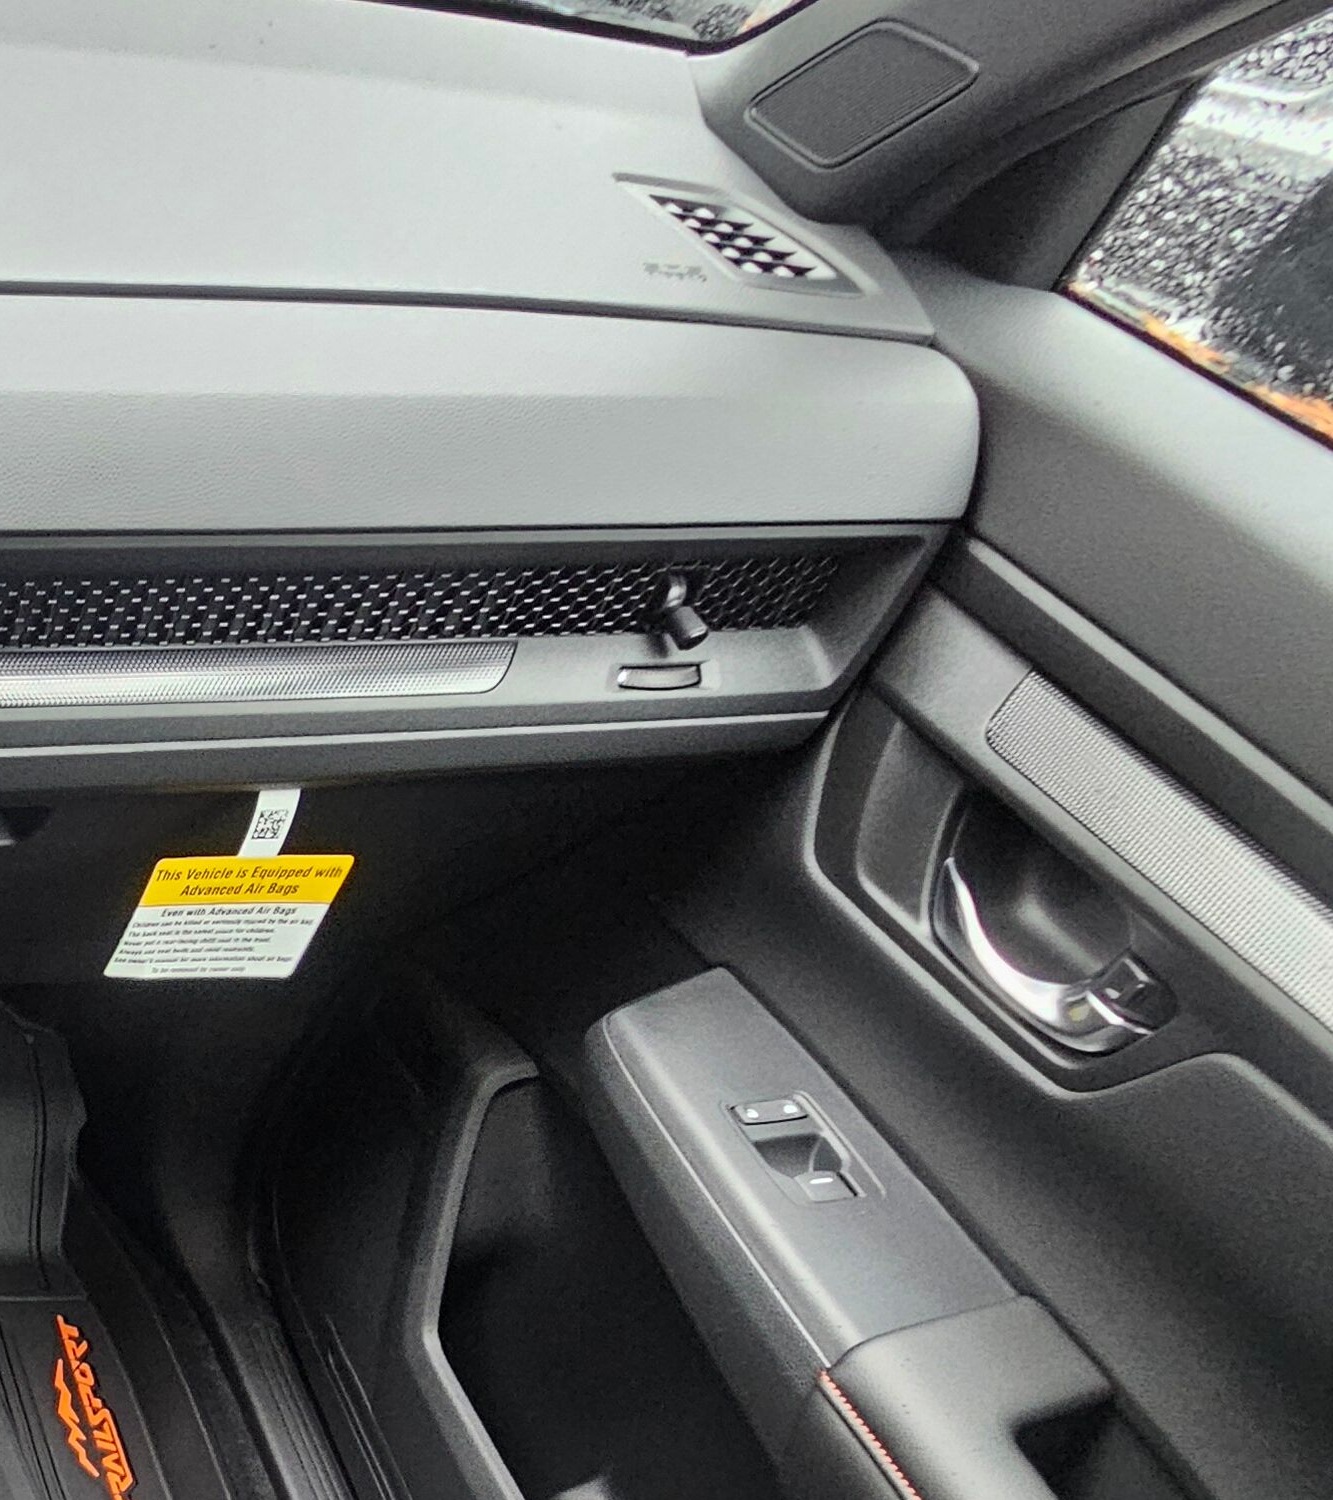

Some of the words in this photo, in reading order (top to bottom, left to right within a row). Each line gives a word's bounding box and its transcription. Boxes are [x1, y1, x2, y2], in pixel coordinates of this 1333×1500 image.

[156, 869, 182, 882] This
[186, 867, 233, 881] Vehicle
[235, 868, 250, 879] is
[251, 866, 313, 881] Equipped
[314, 866, 343, 879] with
[180, 883, 244, 896] Advanced
[244, 882, 265, 894] Air
[267, 882, 300, 897] Bags
[161, 908, 184, 917] Even
[185, 907, 206, 916] with
[208, 906, 254, 917] Advanced
[255, 906, 271, 915] Air
[273, 906, 298, 917] Bags
